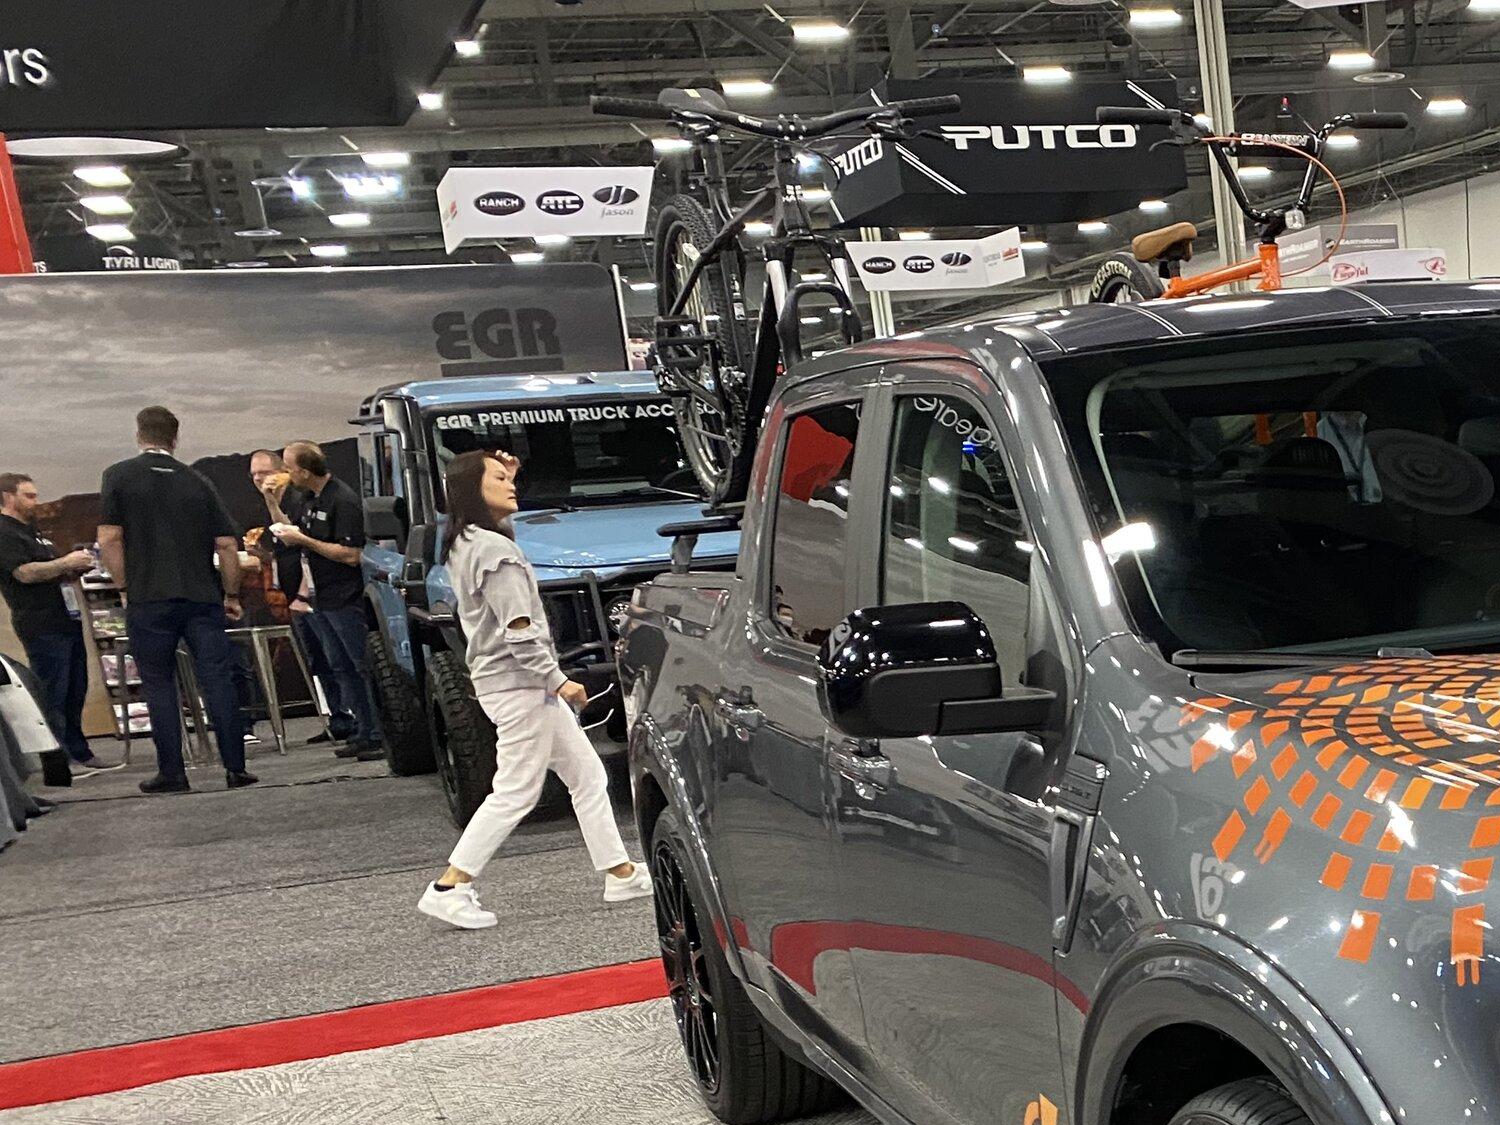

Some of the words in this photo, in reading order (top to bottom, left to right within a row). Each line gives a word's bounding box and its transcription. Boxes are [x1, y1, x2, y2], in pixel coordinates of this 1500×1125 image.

[0, 48, 49, 85] rs
[941, 124, 1136, 149] PUTCO
[833, 138, 883, 179] PUTCO
[479, 198, 519, 207] RANCH
[540, 196, 580, 209] ATC
[102, 257, 140, 269] TYRI
[432, 308, 560, 361] EGR
[436, 415, 474, 430] EGR
[478, 409, 565, 427] PREMIUM
[567, 406, 630, 421] TRUCK
